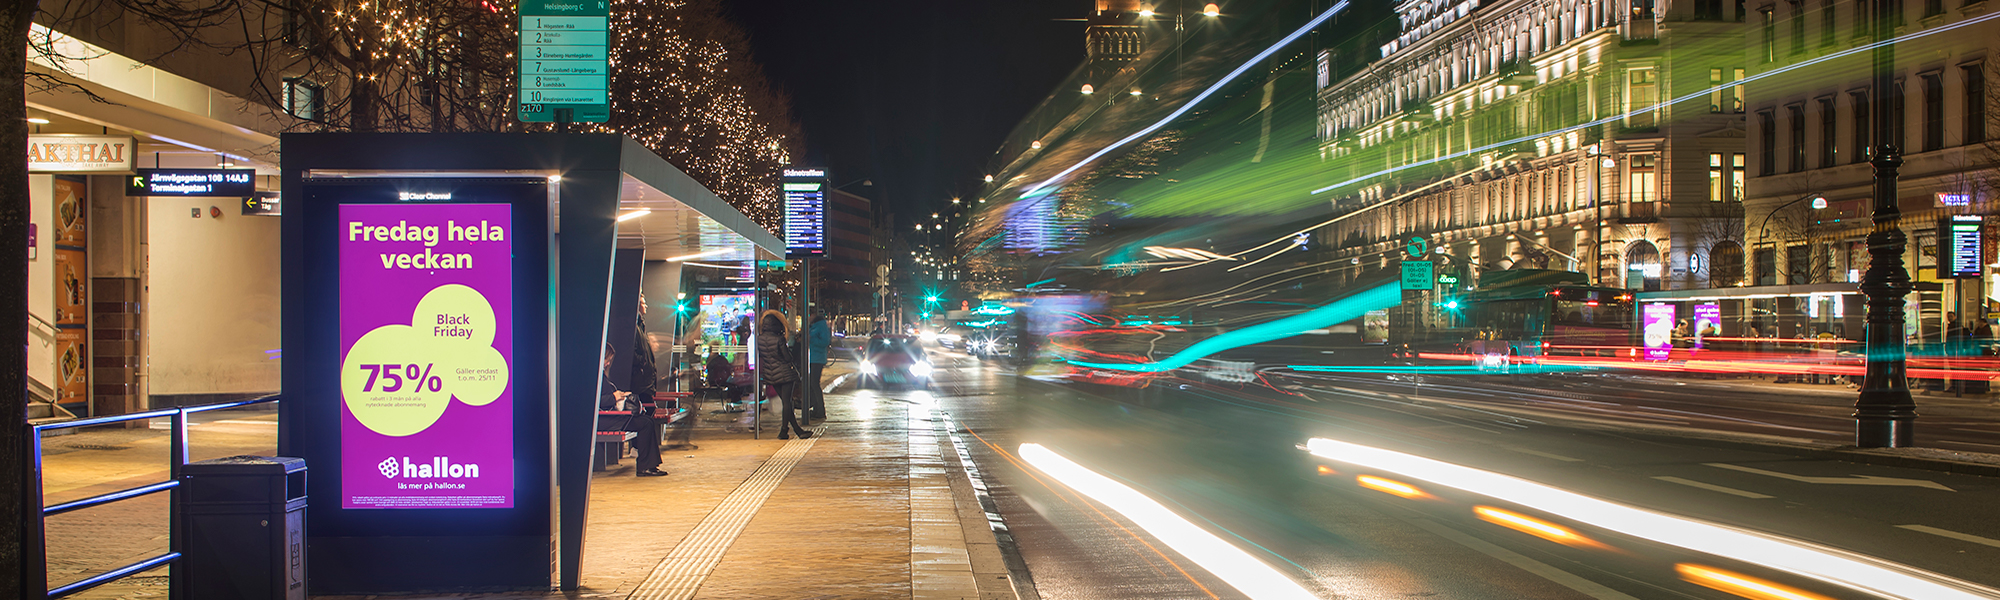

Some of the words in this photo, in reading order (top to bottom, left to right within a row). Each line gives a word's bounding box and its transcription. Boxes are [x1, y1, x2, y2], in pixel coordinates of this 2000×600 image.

[597, 1, 604, 9] N
[537, 18, 542, 28] 1
[536, 33, 542, 43] 2
[536, 47, 542, 58] 3
[536, 62, 542, 72] 7
[536, 76, 542, 87] 8
[531, 91, 542, 102] 10
[150, 173, 207, 184] Järnvägsgatan
[208, 174, 223, 182] 10B
[150, 184, 206, 194] Terminalgatan
[207, 184, 212, 192] 1
[426, 192, 451, 200] Channel
[261, 203, 272, 211] Tåg
[349, 220, 439, 247] Fredag
[448, 220, 504, 241] hela
[380, 248, 473, 269] veckan
[437, 314, 470, 325] Black
[434, 326, 473, 340] Friday
[359, 363, 443, 393] 75%
[403, 456, 479, 478] hallon
[424, 482, 433, 490] på
